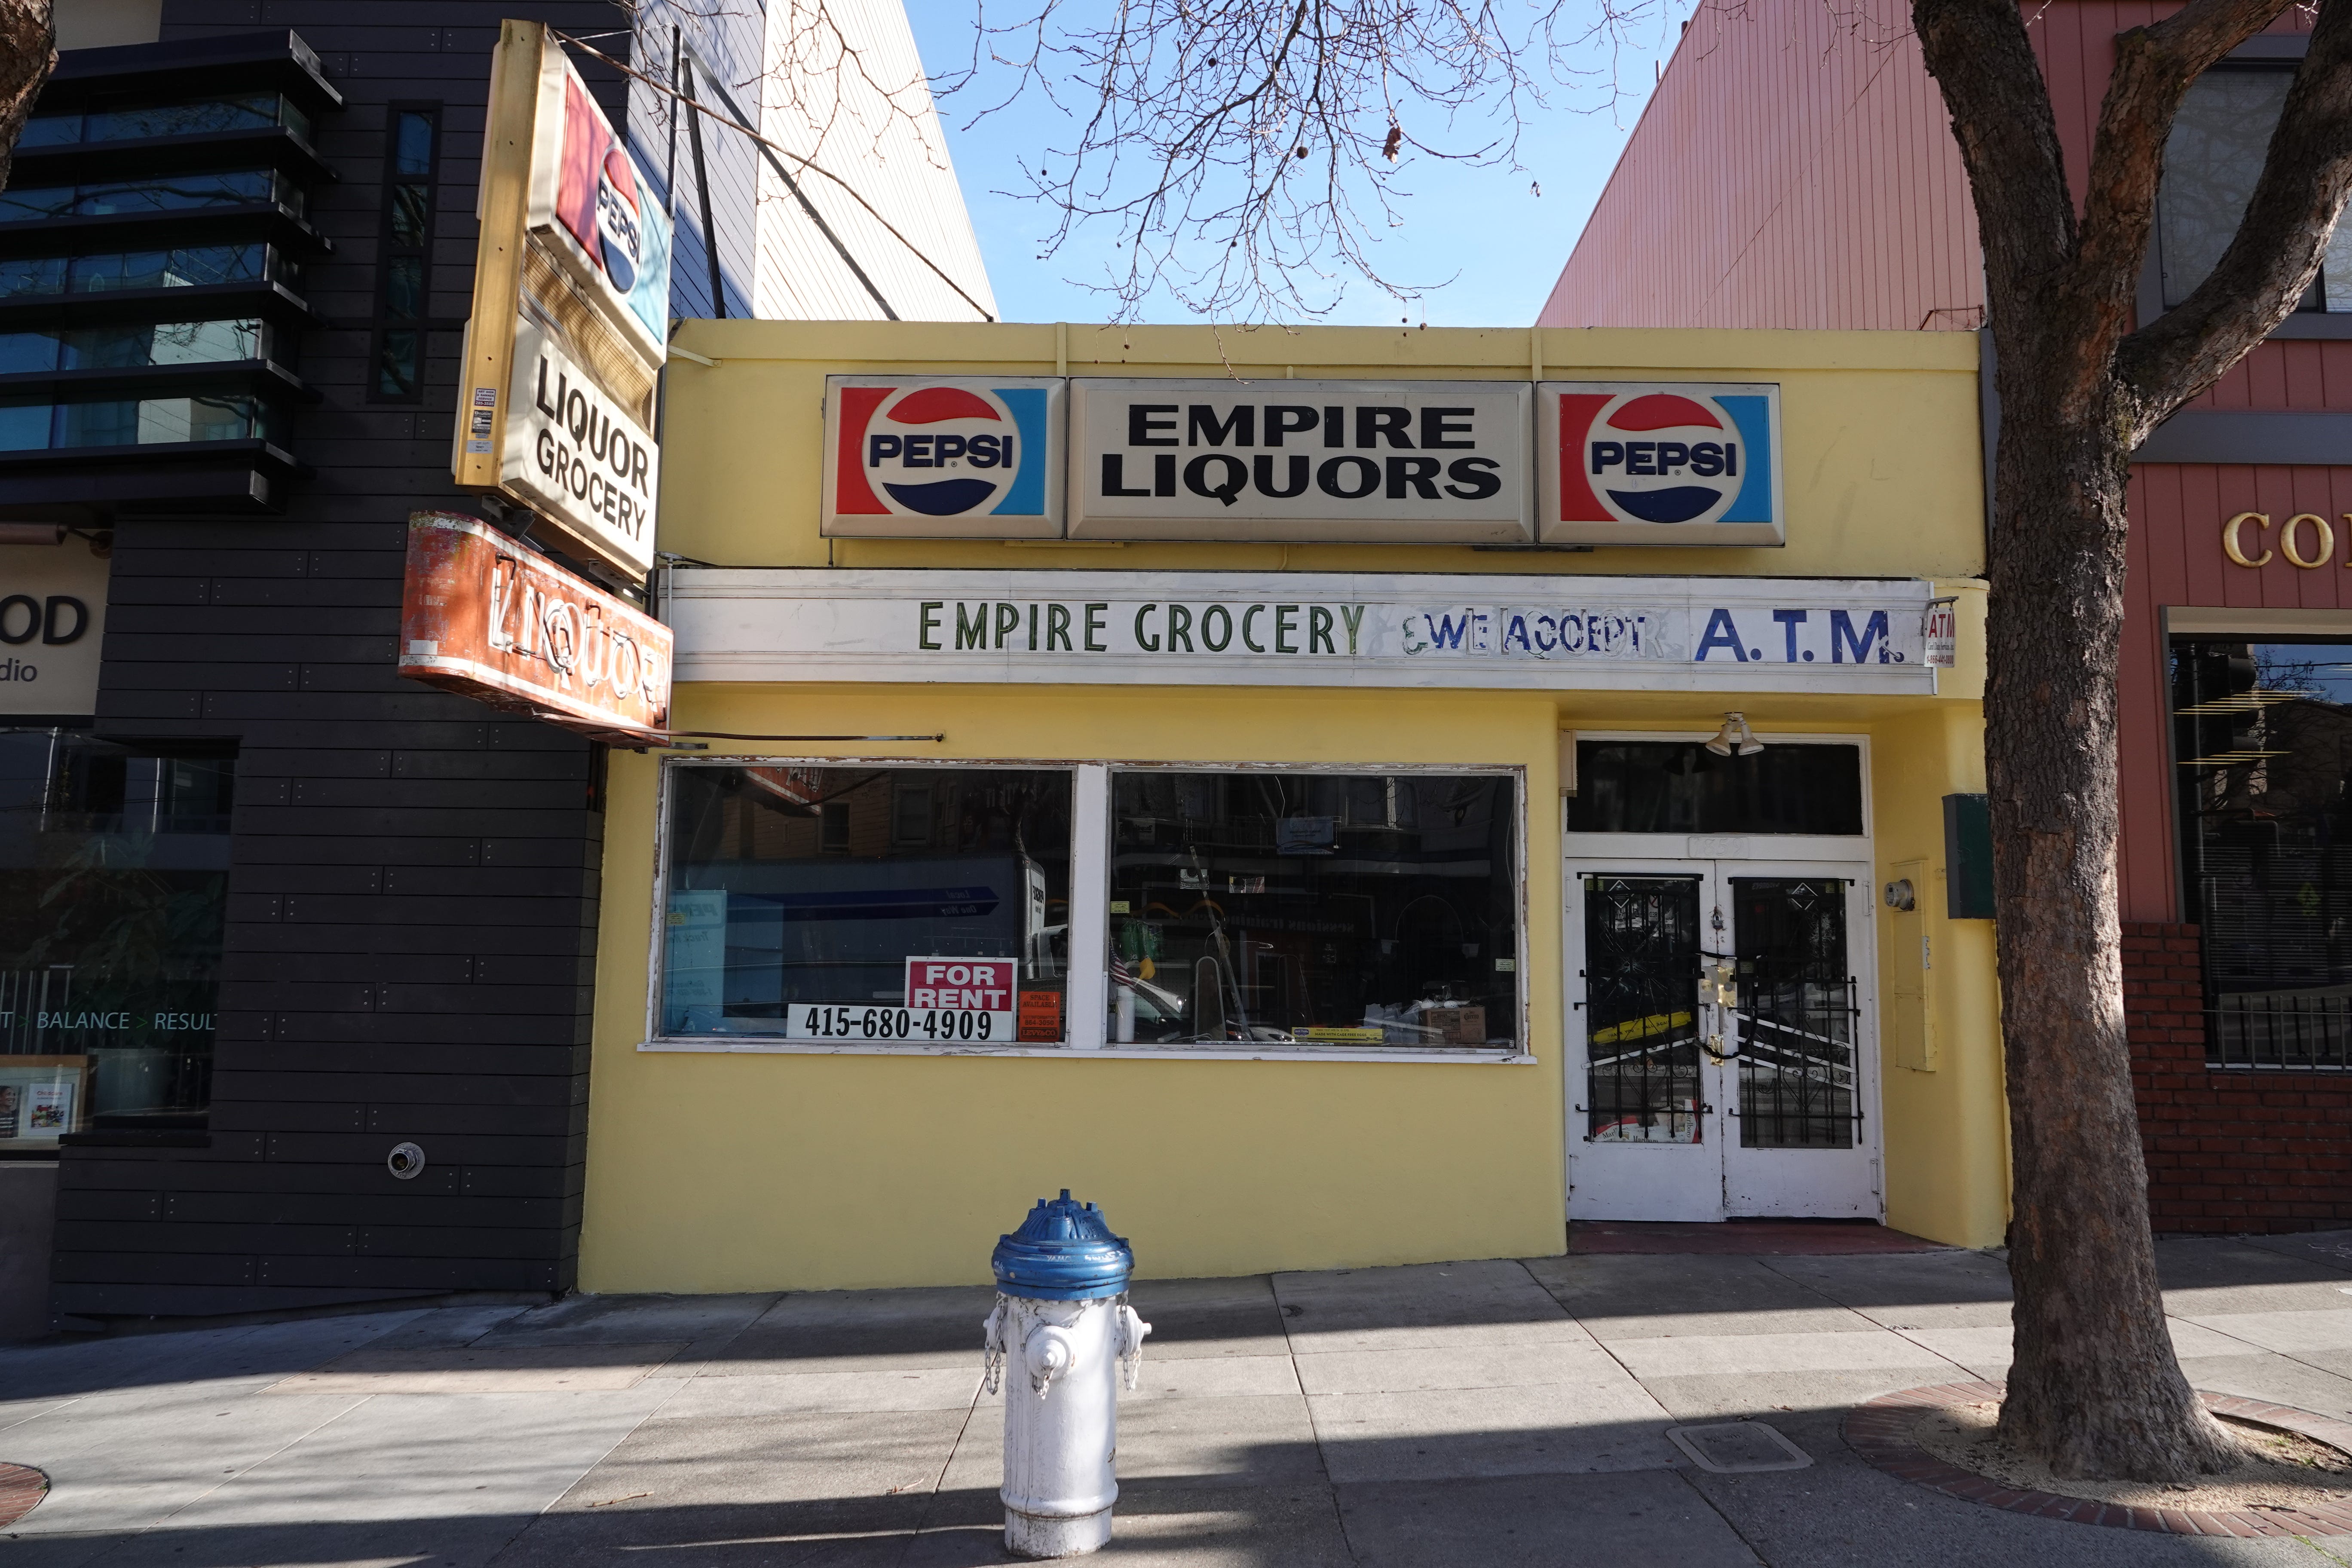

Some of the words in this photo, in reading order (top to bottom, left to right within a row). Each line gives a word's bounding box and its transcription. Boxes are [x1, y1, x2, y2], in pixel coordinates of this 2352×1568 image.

[597, 178, 640, 265] PEPSI
[537, 354, 648, 498] LIQUOR
[1129, 404, 1475, 450] EMPIRE
[870, 435, 1012, 469] PEPSI
[1592, 441, 1736, 477] PEPSI
[537, 429, 646, 542] GROCERY
[1102, 454, 1501, 507] LIQUORS
[488, 567, 669, 712] LIQUOR
[919, 601, 1108, 650] EMPIRE
[1135, 603, 1365, 655] GROCERY
[1694, 608, 1904, 664] A.T.M.
[1929, 613, 1955, 638] ATM
[925, 965, 995, 986] FOR
[37, 1012, 130, 1029] BALANCE
[914, 989, 1007, 1009] RENT
[805, 1007, 992, 1040] 415-680-4909
